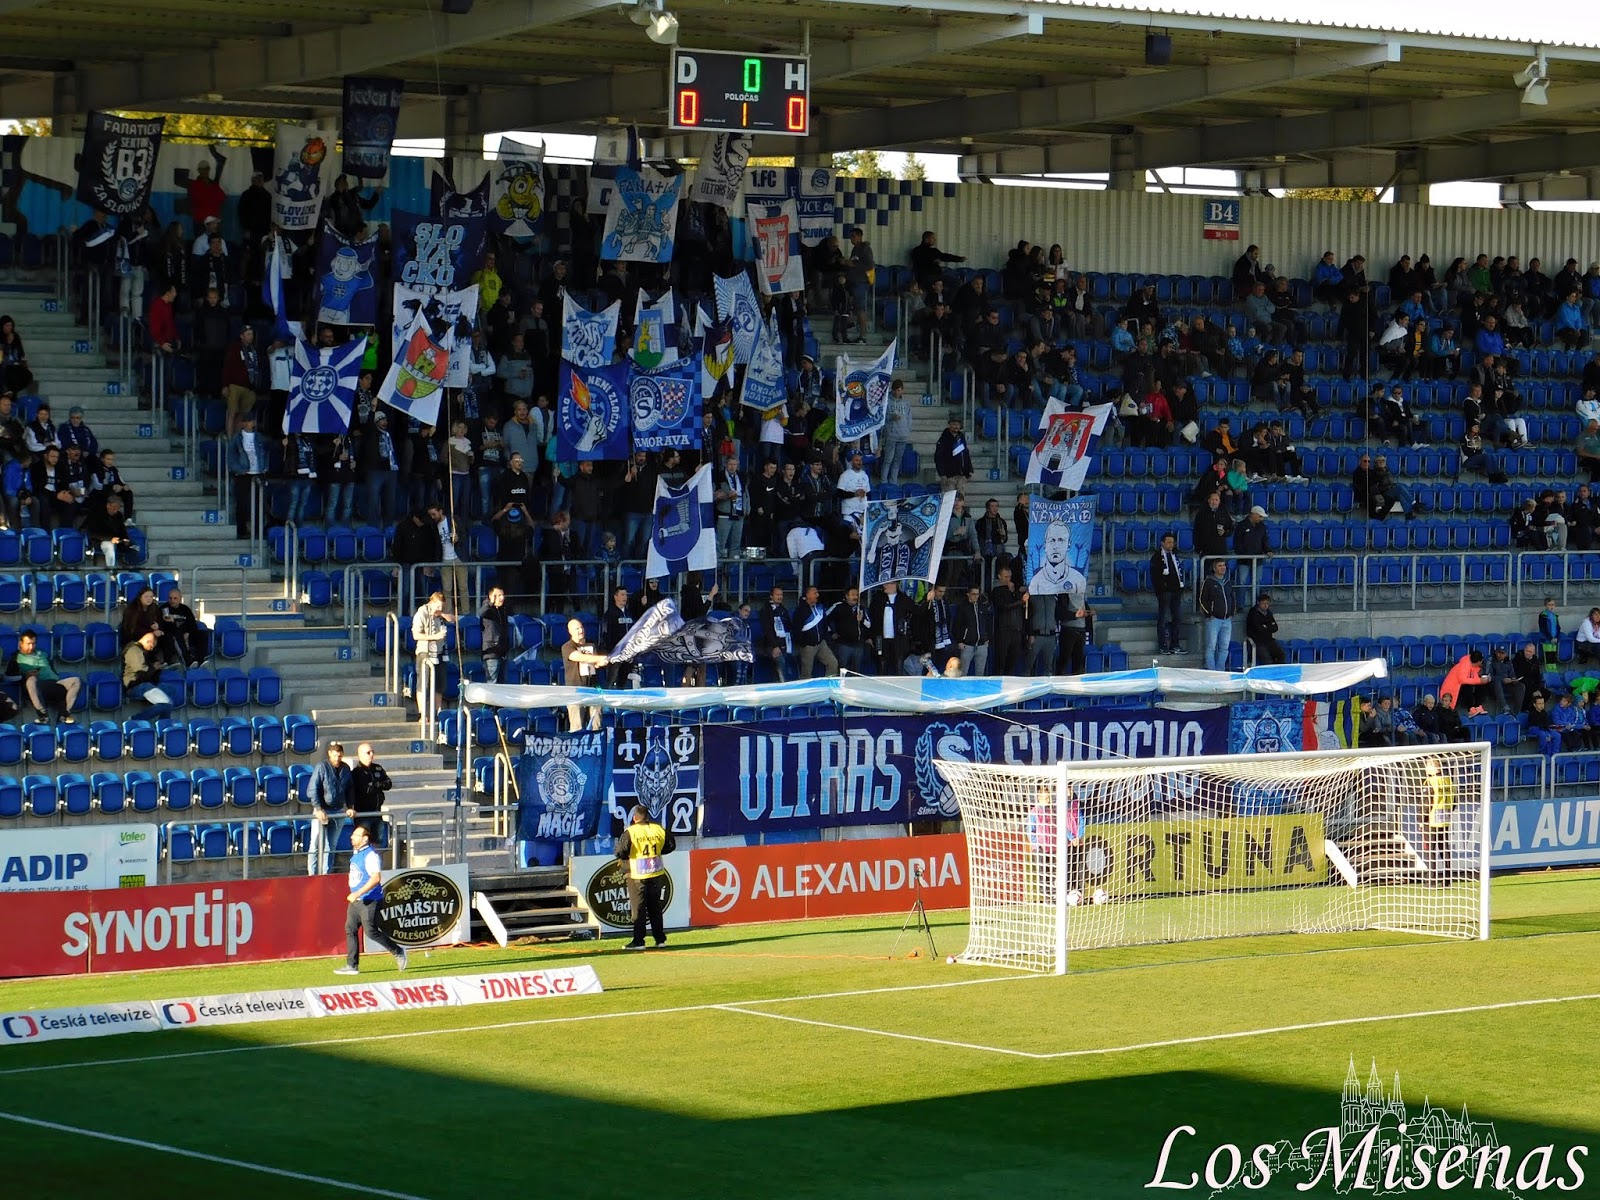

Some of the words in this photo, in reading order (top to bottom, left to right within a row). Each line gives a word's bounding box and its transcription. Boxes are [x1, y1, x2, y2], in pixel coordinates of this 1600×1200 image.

[677, 56, 698, 84] D
[743, 58, 761, 92] 0
[784, 63, 806, 91] H
[680, 90, 697, 124] 0
[724, 92, 760, 102] POLOČAS
[788, 96, 805, 130] 0
[750, 169, 777, 188] 1.FC
[1210, 202, 1234, 222] B4
[414, 222, 465, 246] SLO
[108, 384, 119, 394] 11
[140, 426, 151, 436] 10
[174, 470, 182, 479] 9
[208, 513, 215, 522] 8
[242, 557, 250, 567] 7
[276, 601, 284, 611] 6
[341, 649, 349, 660] 5
[376, 695, 385, 705] 4
[414, 743, 421, 753] 3
[739, 728, 903, 821] ULTRAS
[535, 812, 585, 838] MAGIE
[120, 831, 146, 843] Valeo
[642, 843, 658, 857] 41
[1083, 825, 1316, 887] ORTUNA
[2, 853, 88, 883] ADIP
[751, 852, 962, 900] ALEXANDRIA
[380, 898, 455, 921] VINAŘSTVÍ
[62, 888, 254, 957] SYNOTtip
[392, 924, 445, 940] POLEŠOVICE
[397, 915, 439, 929] Vaďura
[391, 984, 449, 1005] DNES
[480, 975, 578, 1000] iDNES.cz
[200, 997, 244, 1018] Česká
[247, 998, 305, 1013] televize
[320, 990, 379, 1011] DNES
[41, 1015, 87, 1031] Česká
[90, 1008, 152, 1026] televize
